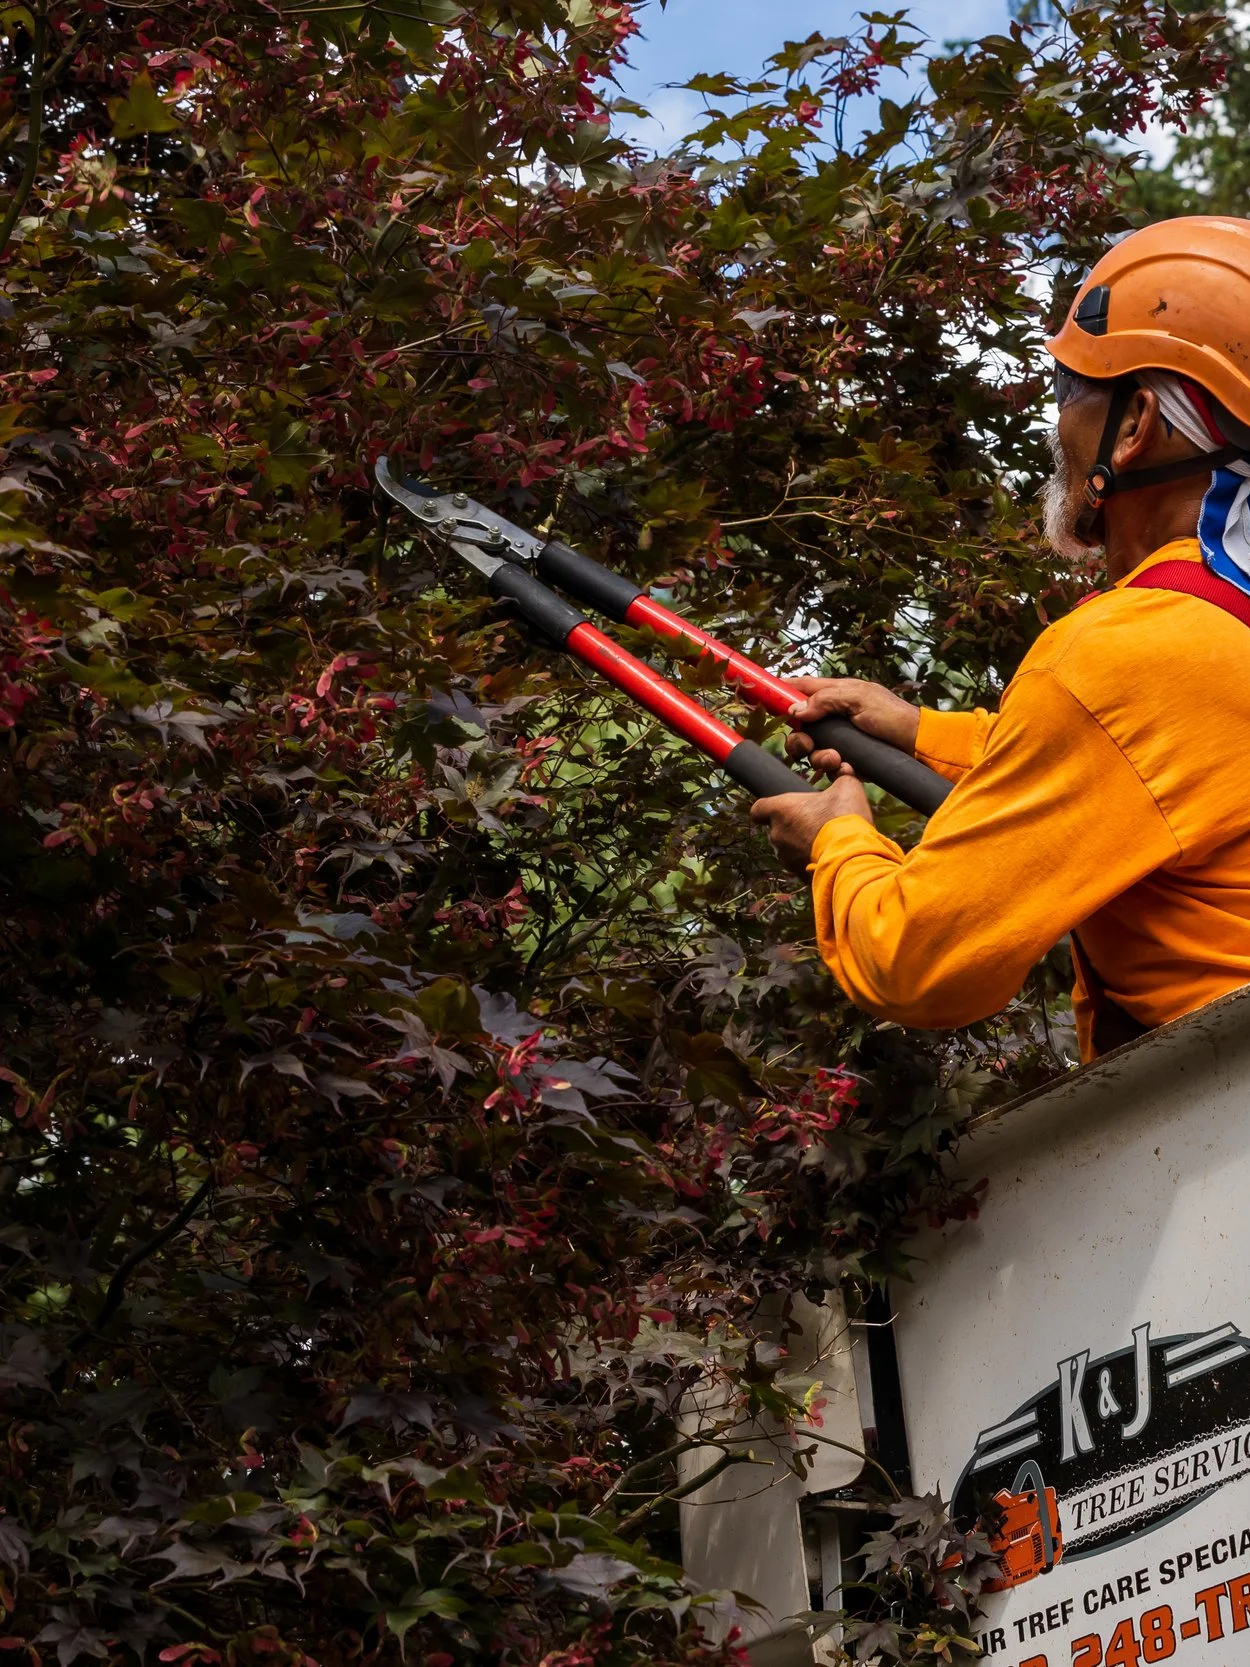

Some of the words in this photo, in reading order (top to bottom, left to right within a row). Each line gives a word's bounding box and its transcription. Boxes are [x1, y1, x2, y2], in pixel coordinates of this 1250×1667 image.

[1057, 1348, 1096, 1464] K
[1098, 1366, 1122, 1419] &
[1121, 1321, 1151, 1439] J
[1071, 1474, 1145, 1531] TREE
[972, 1627, 1007, 1656] UR
[1083, 1567, 1151, 1615] CARE
